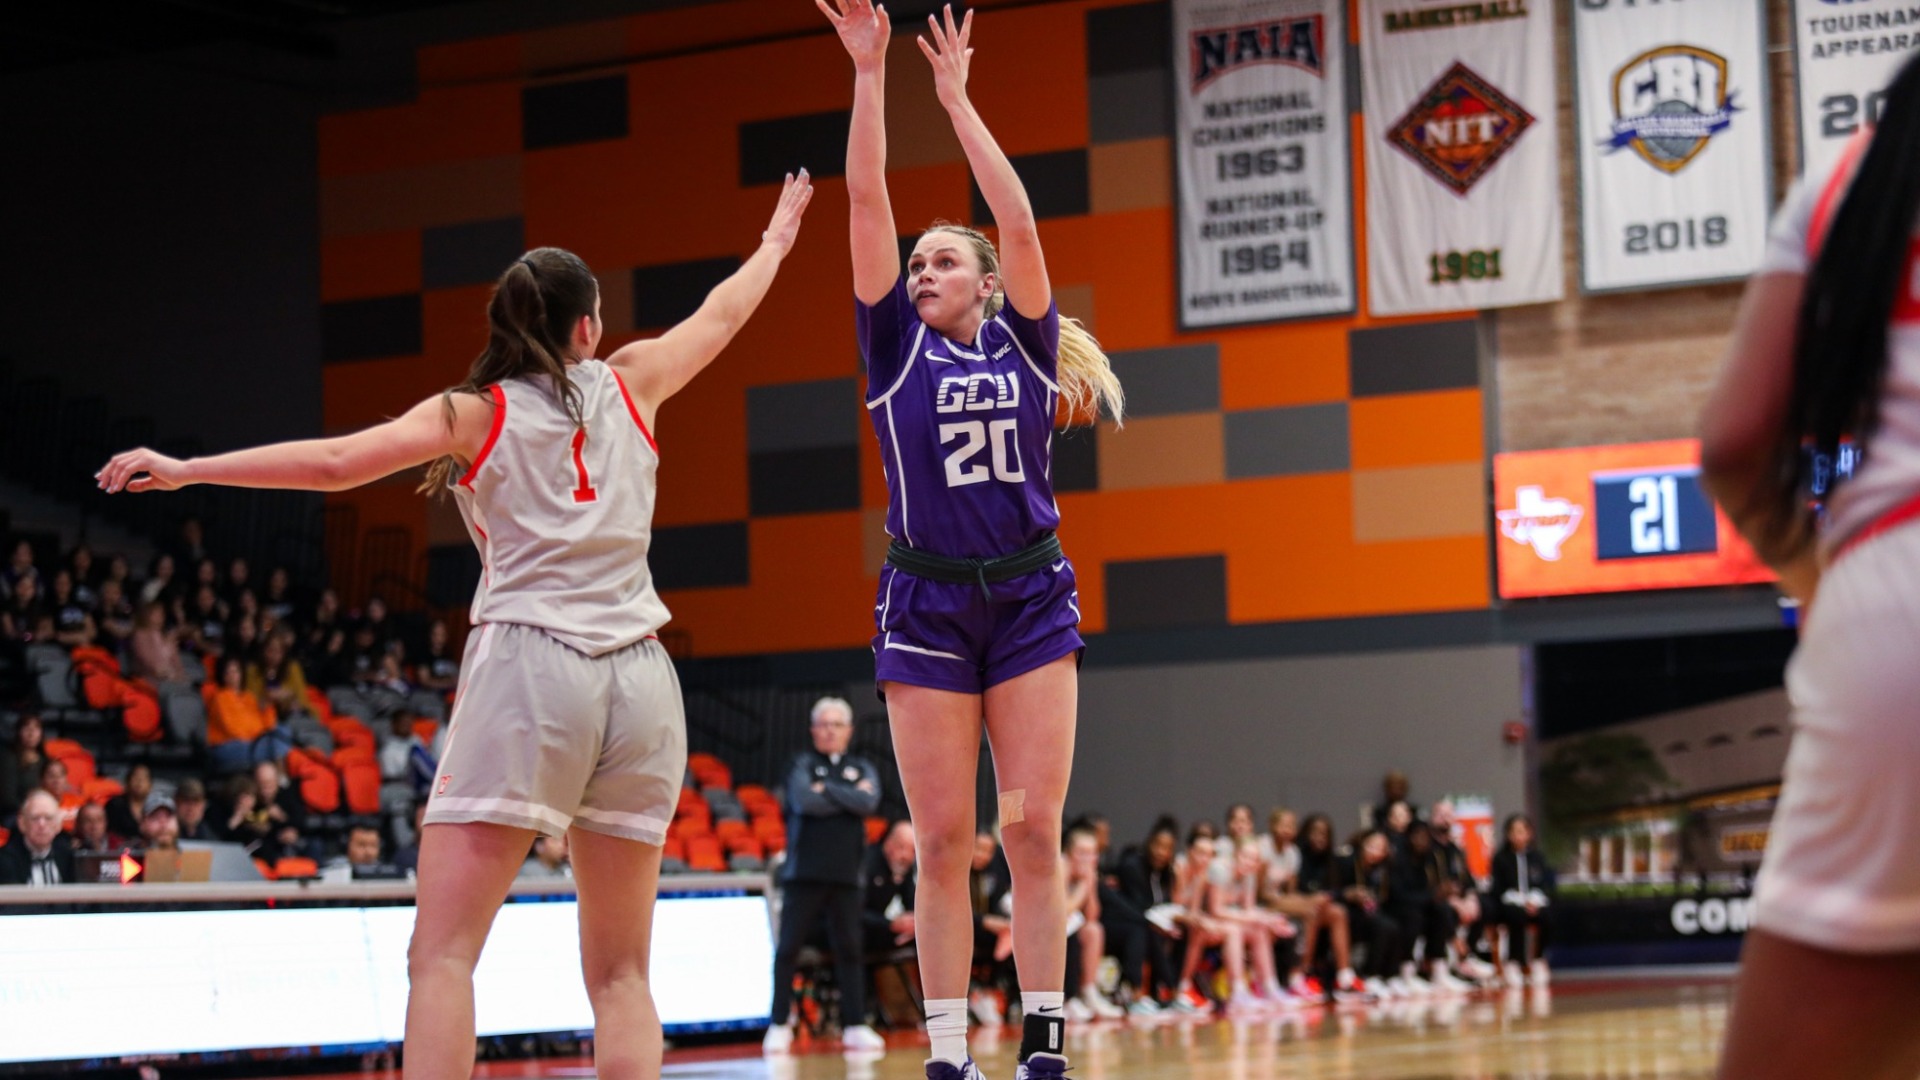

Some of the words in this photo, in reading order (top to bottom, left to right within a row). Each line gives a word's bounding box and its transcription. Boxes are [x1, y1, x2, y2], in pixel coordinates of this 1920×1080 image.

[1195, 20, 1320, 81] NAIA
[1204, 92, 1313, 119] NATIONAL
[1192, 114, 1325, 147] CHAMPIONS
[1424, 113, 1500, 147] NIT
[1217, 144, 1305, 182] 1963
[1206, 189, 1315, 215] NATIONAL
[1201, 210, 1325, 240] RUNNER-UP
[1623, 216, 1729, 256] 2018
[1221, 239, 1310, 278] 1964
[1429, 249, 1503, 284] 1981
[991, 341, 1012, 361] WAC
[936, 371, 1020, 414] GCU
[569, 425, 598, 504] 1
[938, 418, 1027, 488] 20
[1628, 474, 1680, 554] 21
